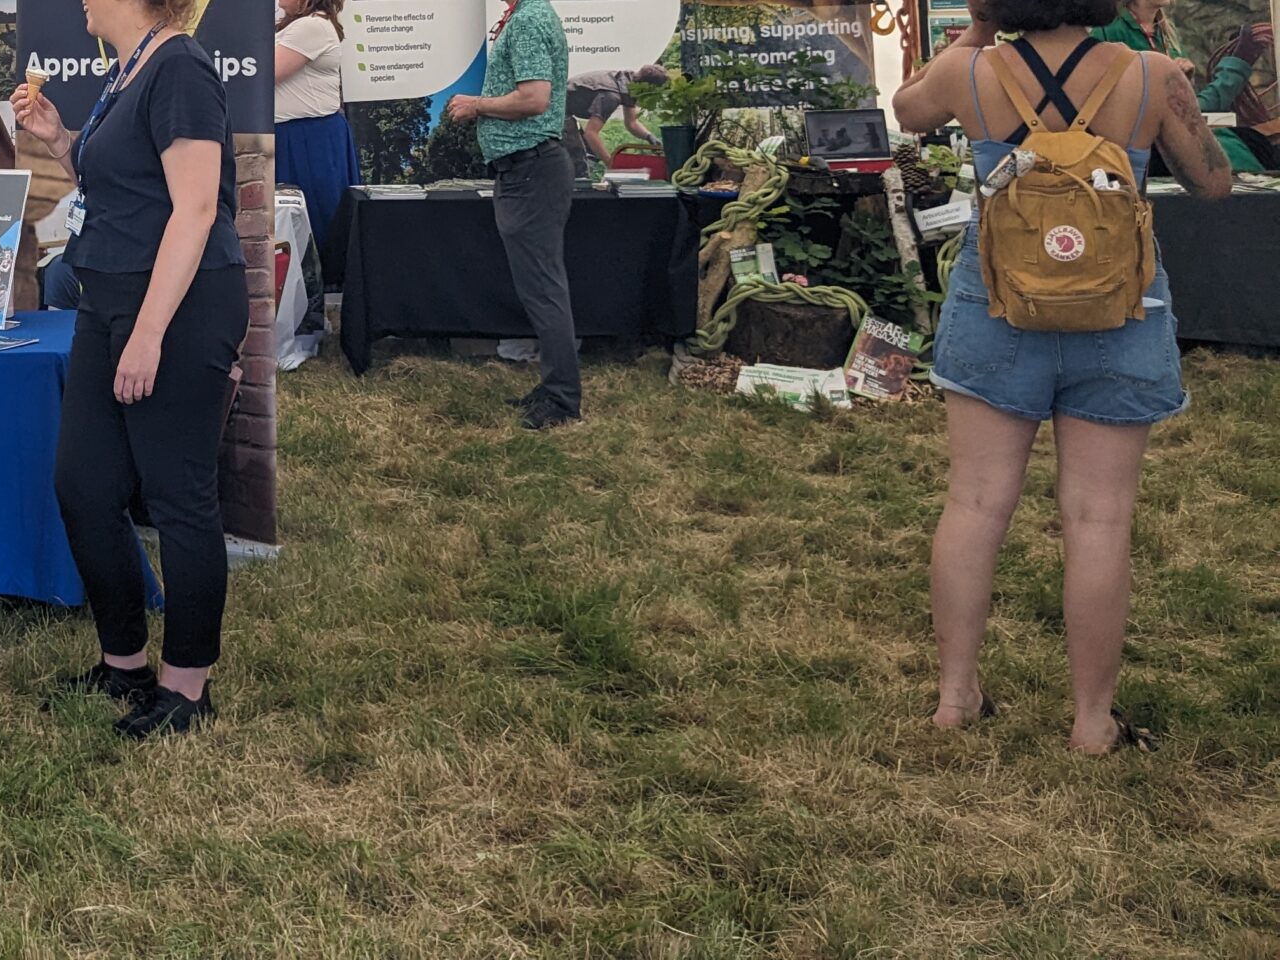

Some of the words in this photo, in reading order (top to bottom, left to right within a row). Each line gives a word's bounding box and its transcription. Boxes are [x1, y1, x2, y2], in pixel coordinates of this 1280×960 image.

[365, 14, 392, 23] Reverse
[393, 13, 402, 21] the
[404, 13, 426, 21] effects
[427, 12, 434, 20] of
[564, 15, 580, 23] and
[581, 15, 614, 24] support
[367, 25, 390, 33] climate
[391, 24, 414, 34] change
[680, 24, 755, 43] nspiring,
[760, 19, 862, 40] supporting
[368, 44, 394, 53] Improve
[395, 43, 431, 52] biodiversity
[575, 45, 620, 54] integration
[370, 63, 386, 71] Save
[387, 62, 424, 71] endangered
[371, 74, 395, 83] species
